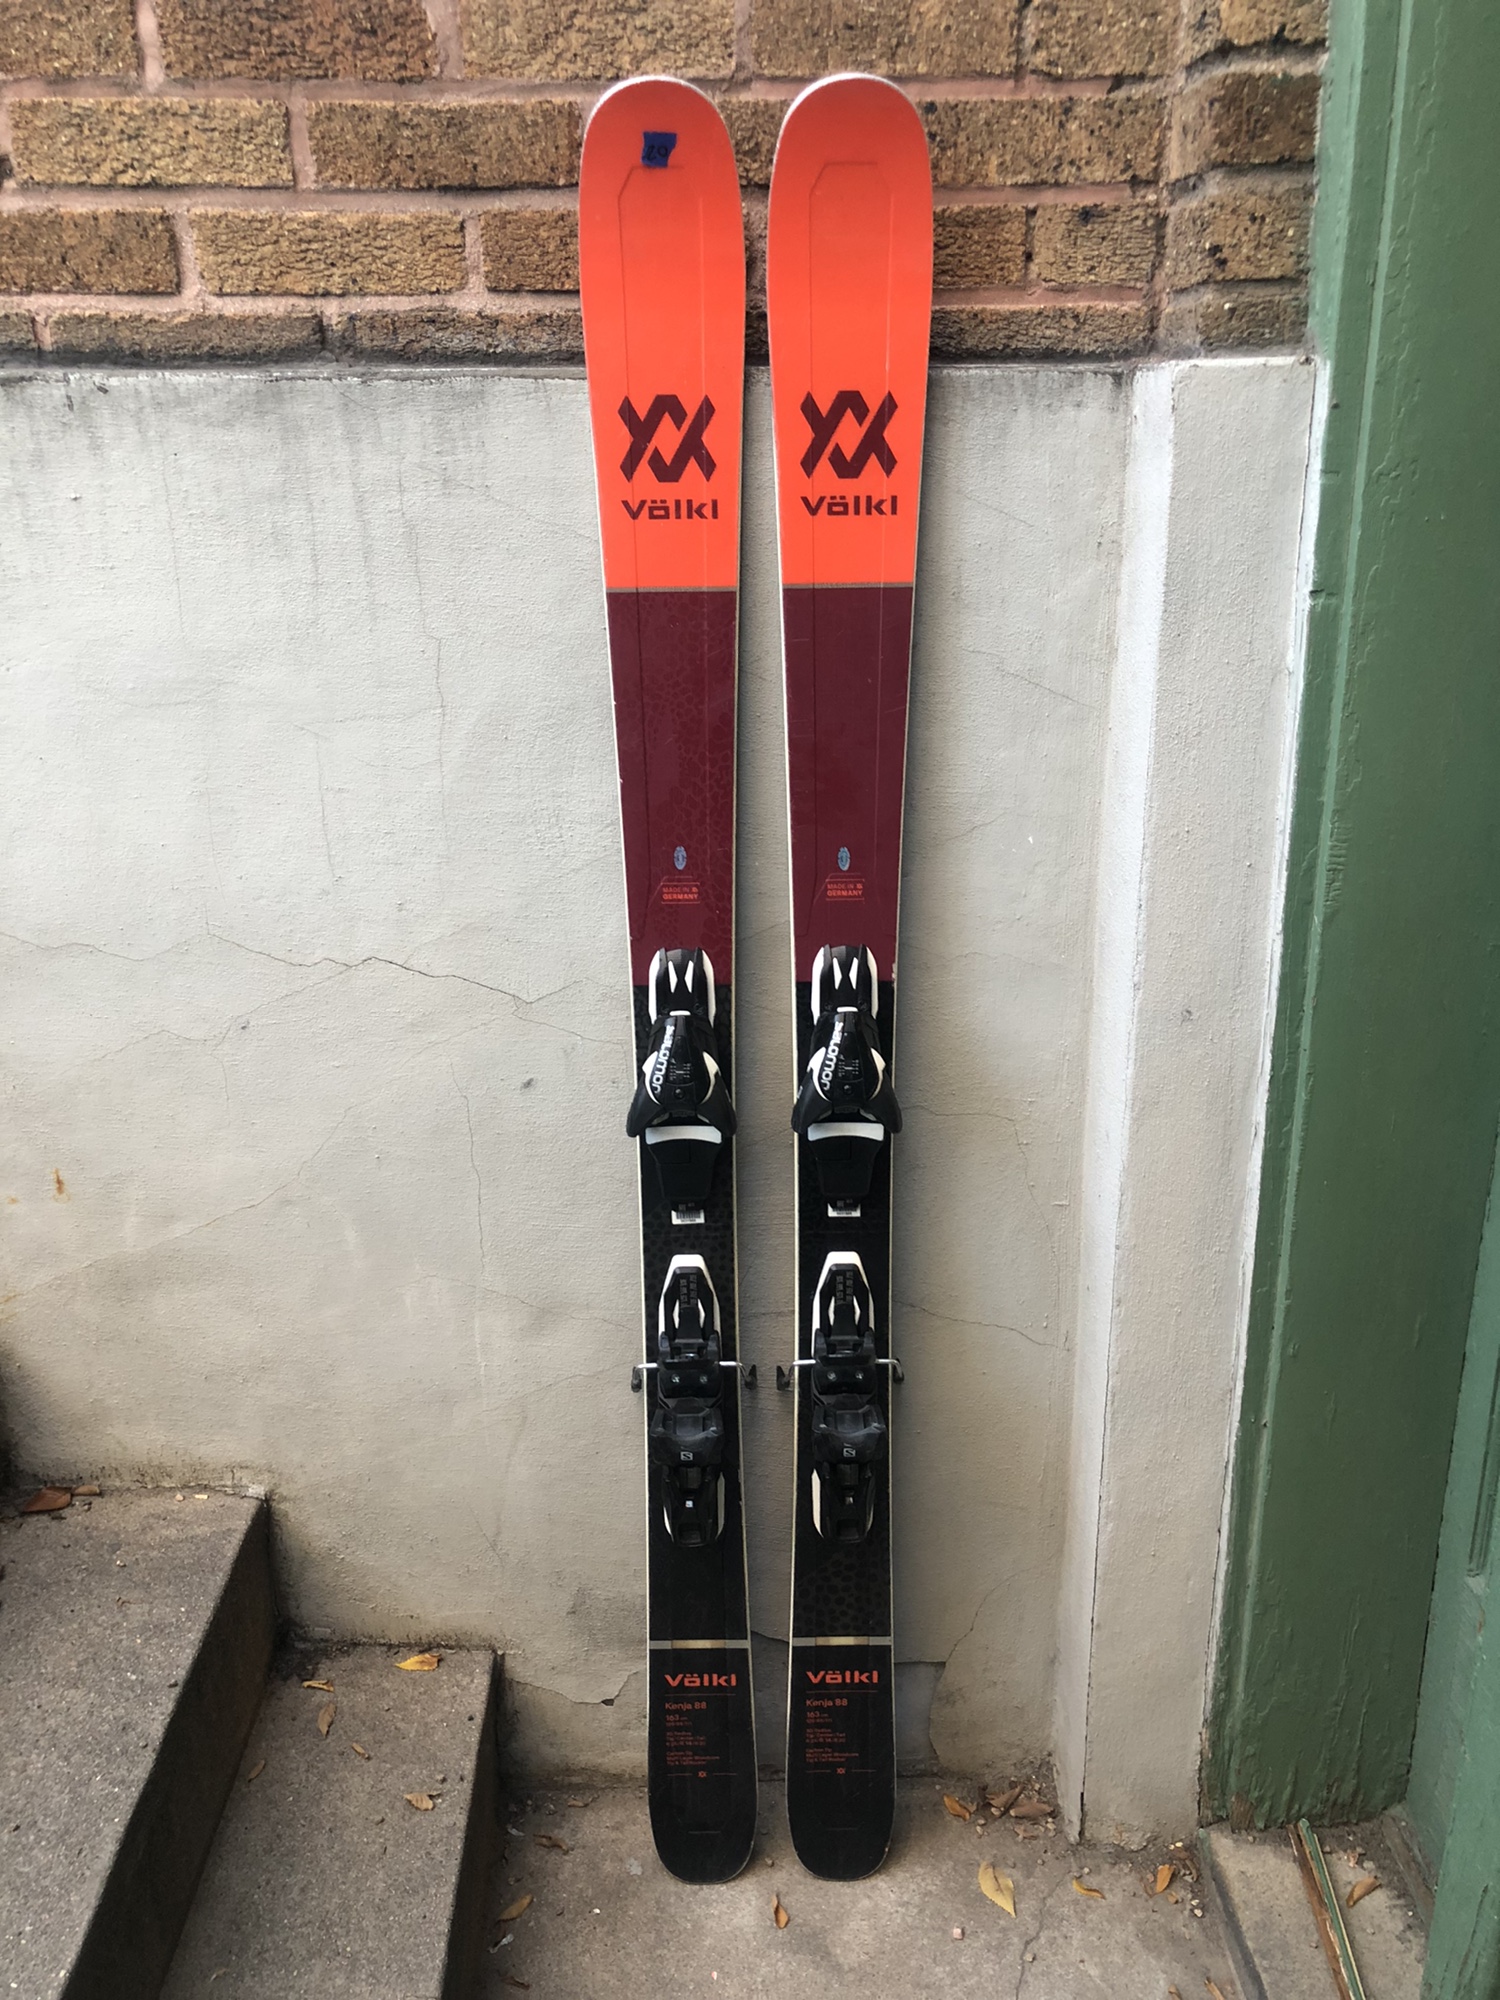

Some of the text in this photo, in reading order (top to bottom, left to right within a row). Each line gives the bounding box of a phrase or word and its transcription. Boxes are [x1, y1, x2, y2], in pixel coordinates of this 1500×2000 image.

[621, 499, 718, 520] Völkl
[800, 495, 898, 516] Völkl
[664, 1673, 737, 1687] Völkl
[806, 1670, 879, 1684] Völkl
[665, 1701, 707, 1711] Kenja 88
[805, 1698, 848, 1708] Kenja 88
